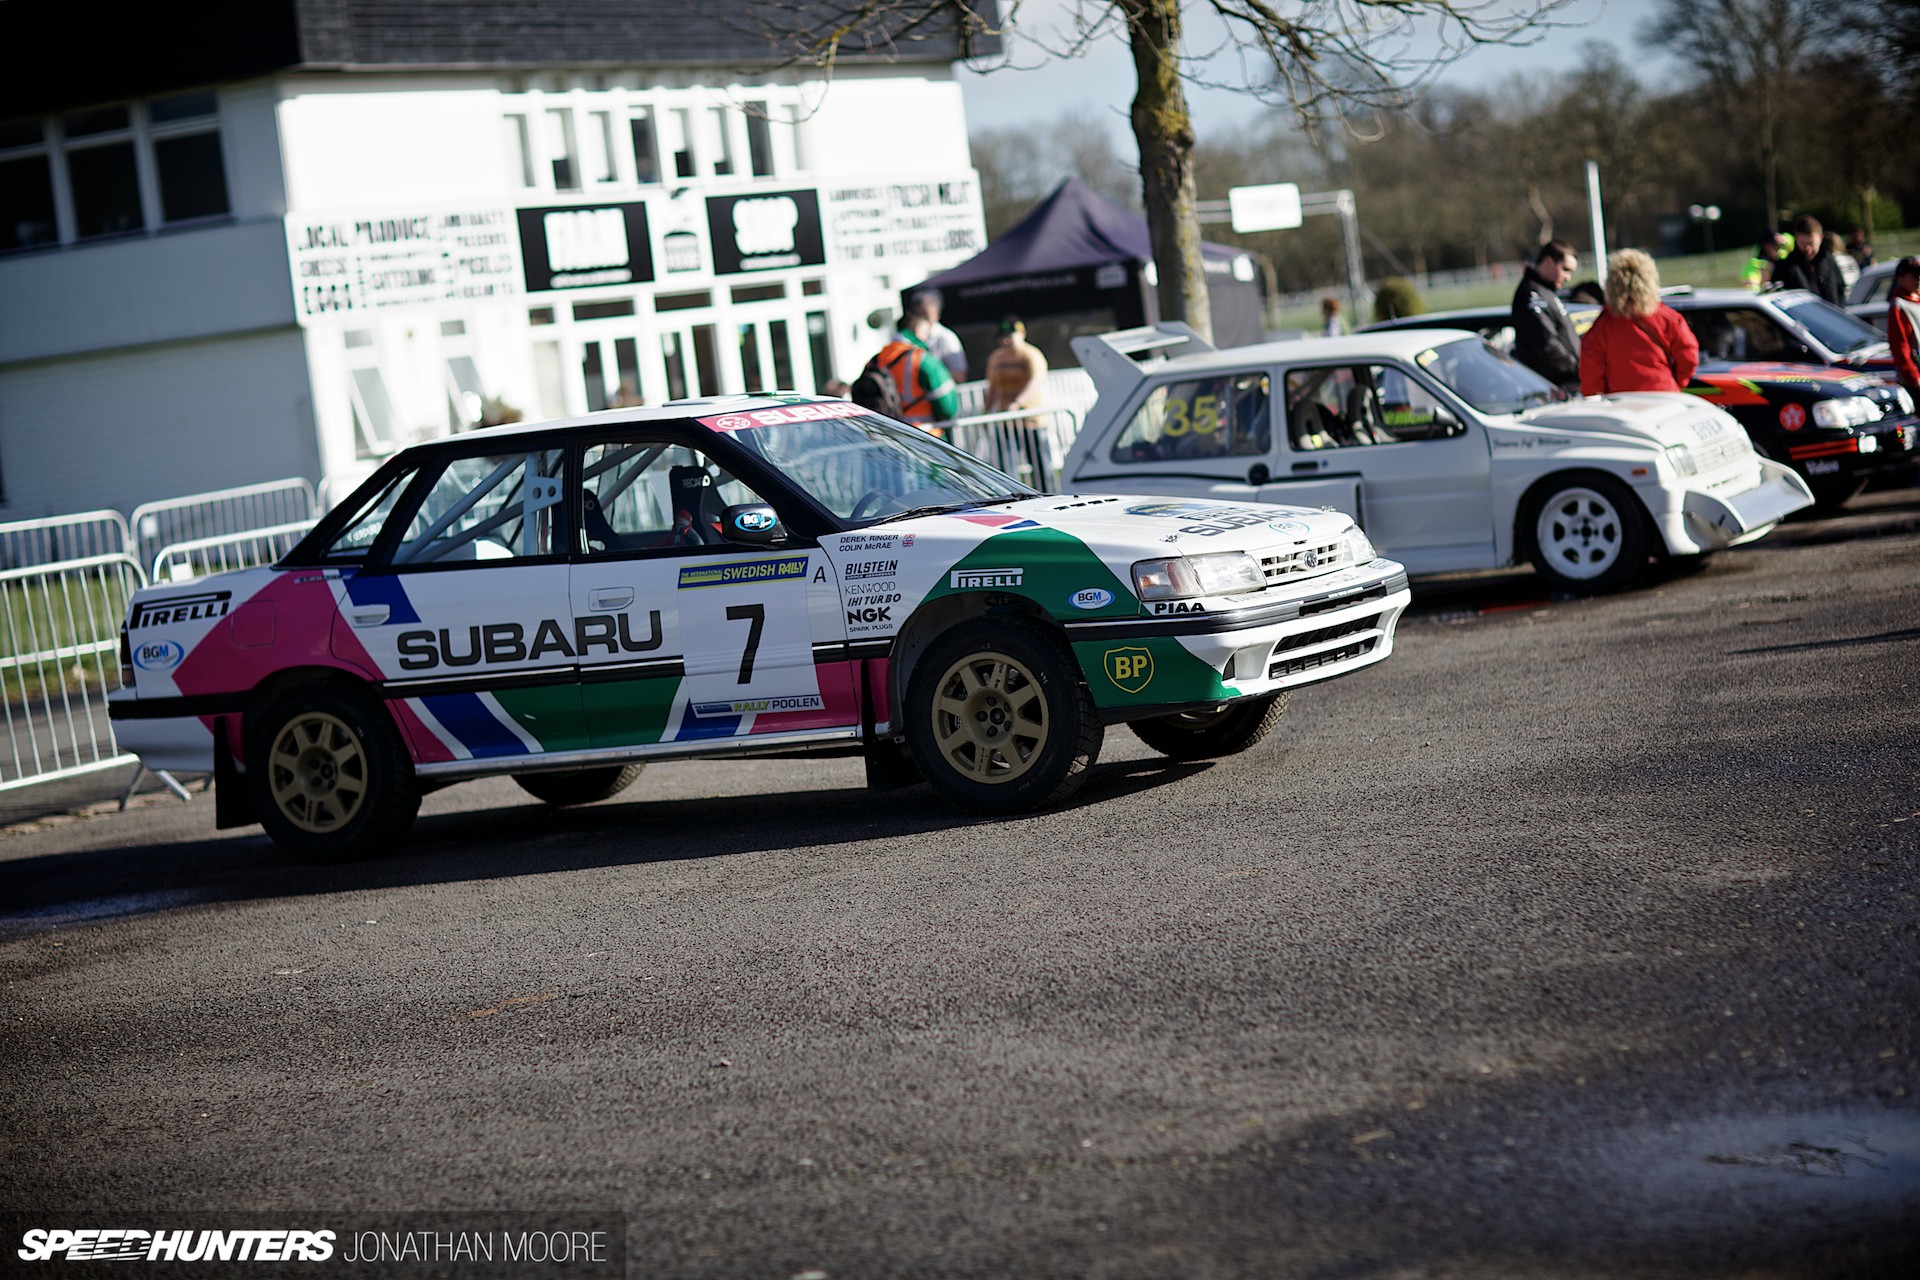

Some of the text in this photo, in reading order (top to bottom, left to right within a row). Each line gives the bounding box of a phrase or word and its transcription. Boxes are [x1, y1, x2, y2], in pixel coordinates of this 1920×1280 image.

[750, 402, 869, 425] SUBARU
[1163, 396, 1218, 437] 35
[839, 541, 892, 552] COLIN McRAE
[840, 534, 899, 544] DEREK RINGER
[722, 563, 776, 581] SWEDISH
[778, 560, 806, 575] RALLY
[813, 566, 827, 584] A
[845, 560, 898, 575] BILSTEIN
[951, 567, 1024, 589] PIRELLI
[845, 581, 896, 596] KENWOOD
[848, 593, 902, 607] IHI TURBO
[1077, 592, 1102, 602] BGM
[129, 590, 233, 630] PIRELLI
[847, 605, 892, 625] NGK
[1154, 602, 1206, 614] PIAA
[872, 623, 893, 631] PLUGS
[397, 610, 663, 671] SUBARU
[725, 603, 765, 685] 7
[143, 644, 169, 659] BGM
[1115, 654, 1148, 680] BP
[733, 701, 770, 712] RALLY
[772, 697, 819, 709] POOLEN
